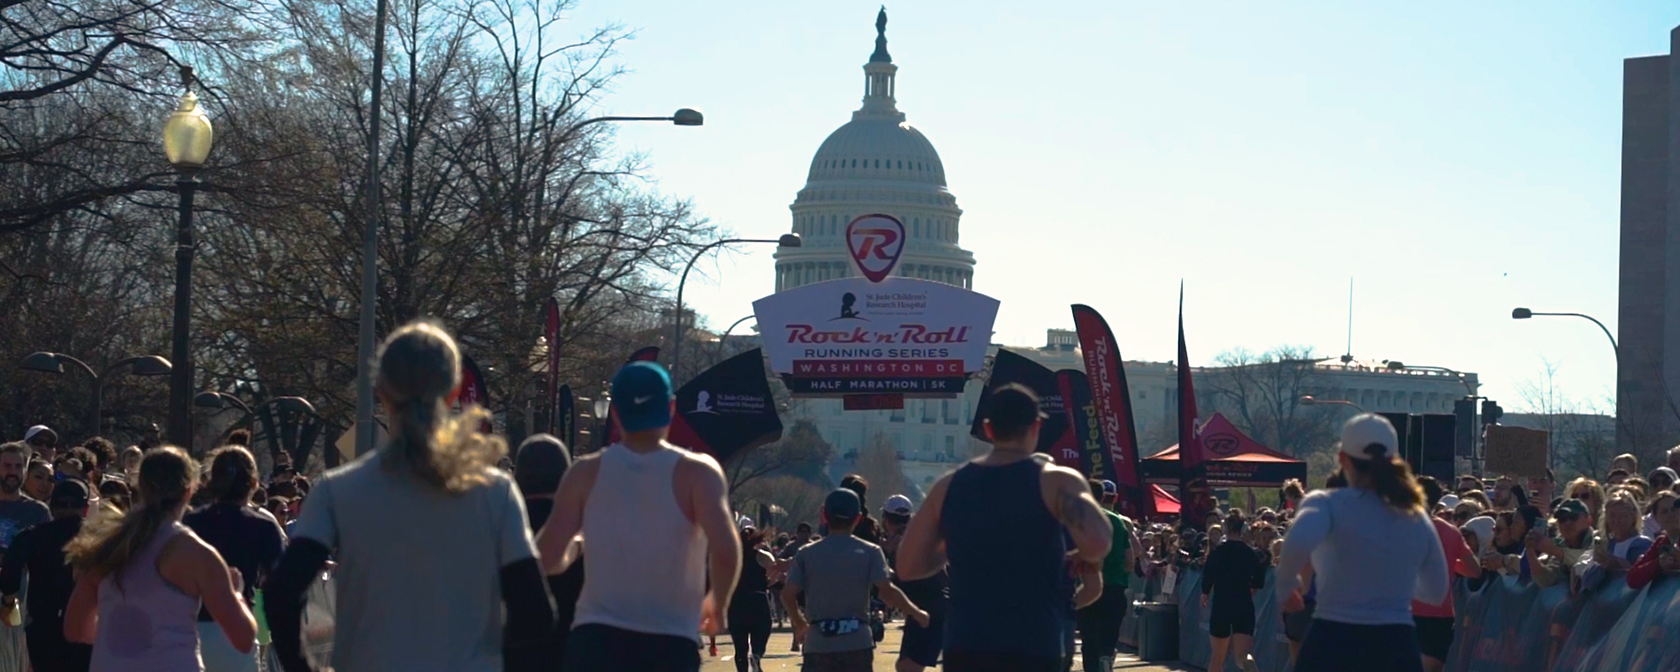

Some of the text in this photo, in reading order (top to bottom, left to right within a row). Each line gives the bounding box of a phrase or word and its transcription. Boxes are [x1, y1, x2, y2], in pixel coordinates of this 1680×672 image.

[852, 228, 899, 260] R
[875, 293, 891, 301] Jude
[897, 301, 927, 309] Hospital
[785, 324, 871, 344] Rock
[899, 324, 969, 344] Roll
[805, 348, 949, 358] RUNNING SERIES
[800, 363, 958, 372] WASHINGTON DC
[1094, 336, 1112, 395] Rock
[811, 380, 946, 389] HALF MARATHON 5K
[1082, 400, 1100, 450] Feed.
